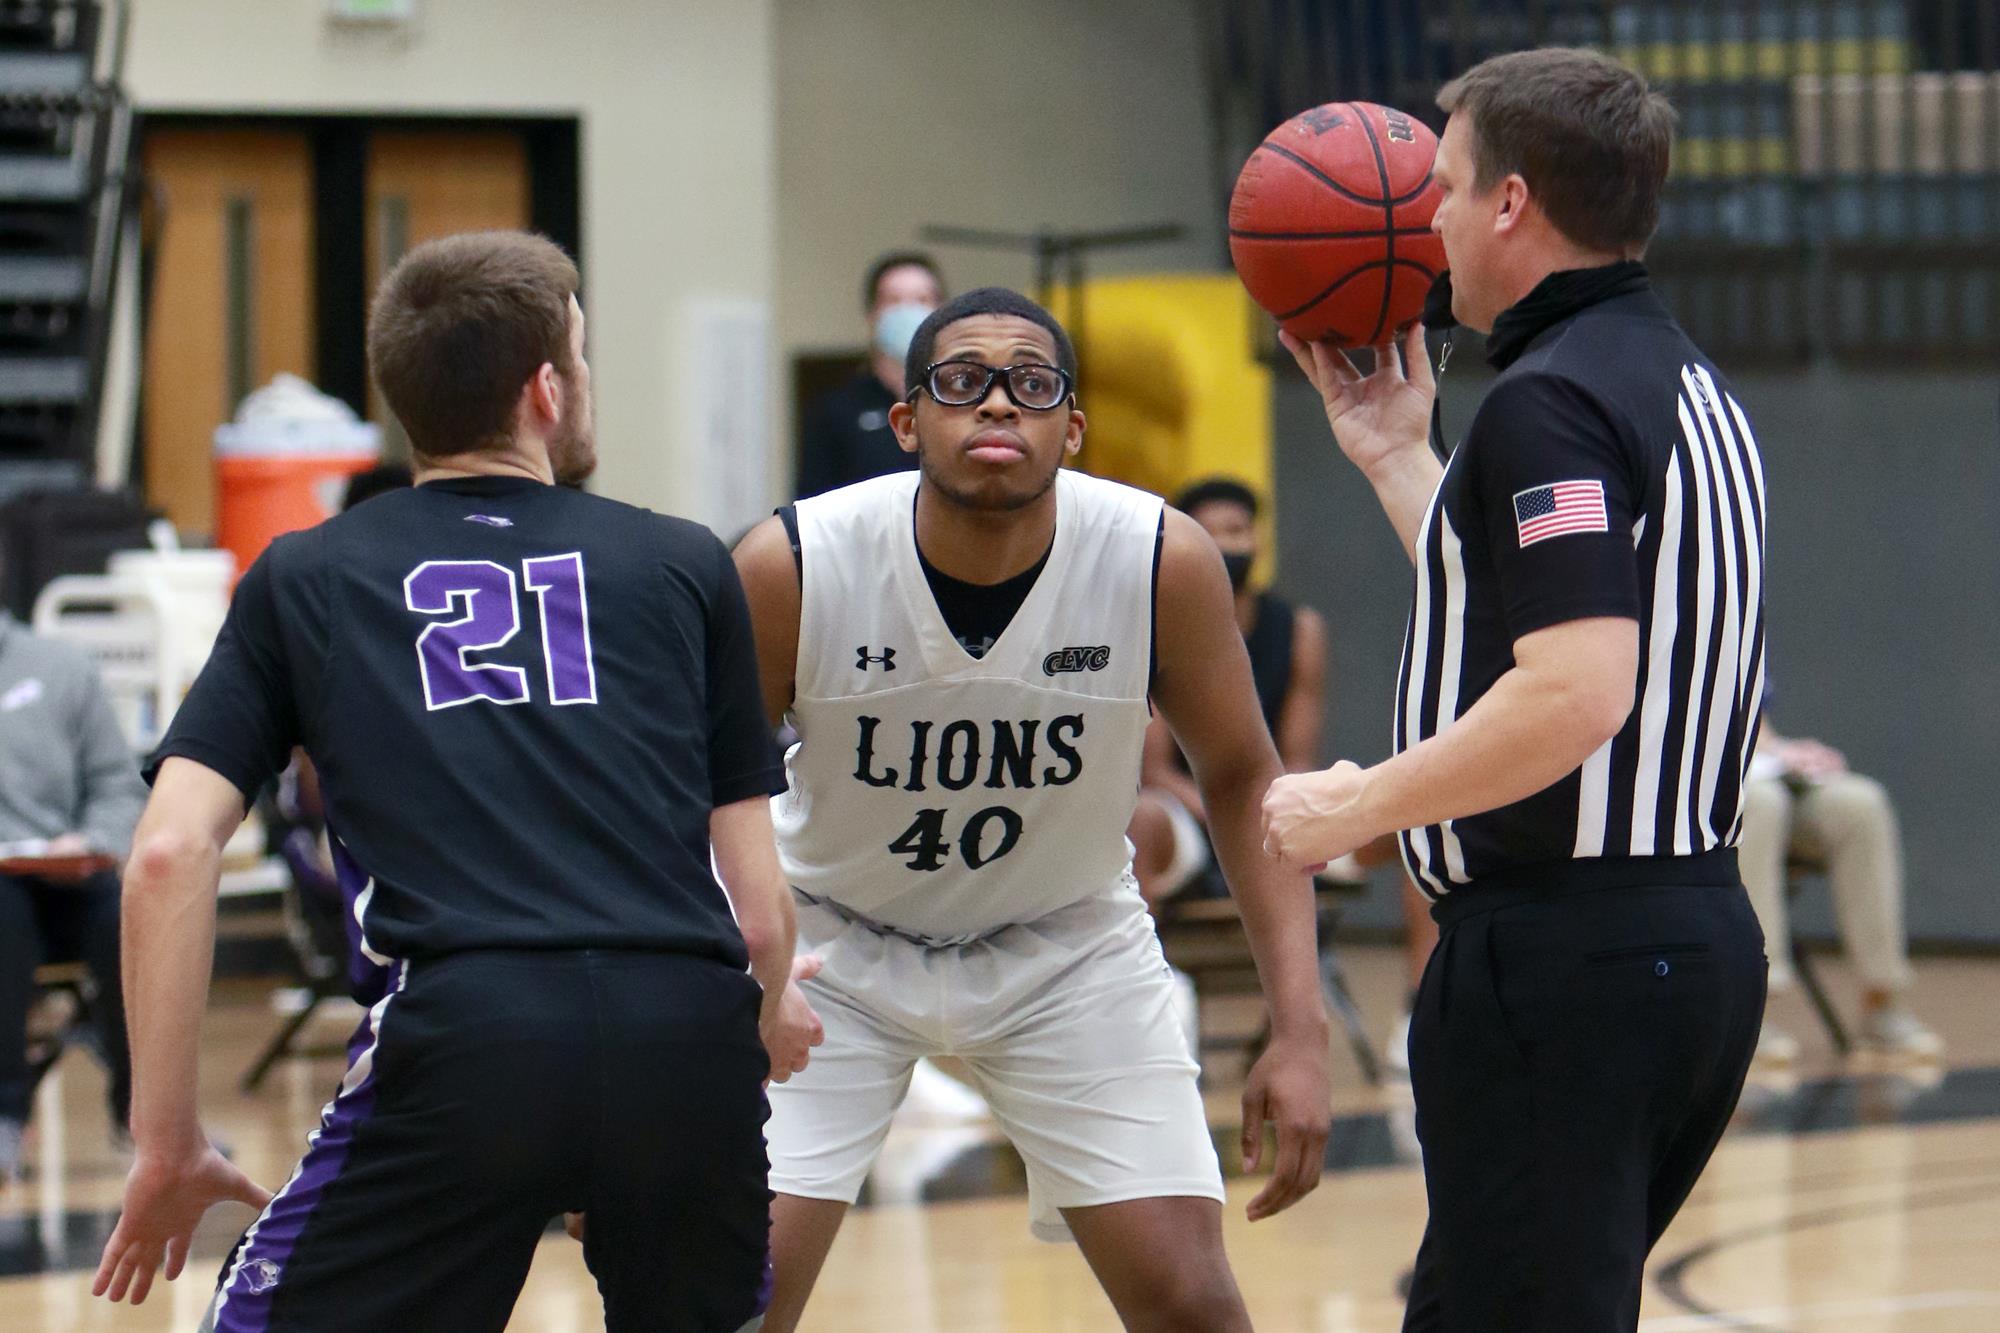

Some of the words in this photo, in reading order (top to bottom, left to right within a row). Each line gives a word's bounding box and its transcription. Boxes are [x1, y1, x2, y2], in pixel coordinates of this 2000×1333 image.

[402, 550, 599, 711] 21
[853, 713, 1085, 793] LIONS
[888, 805, 1024, 872] 40
